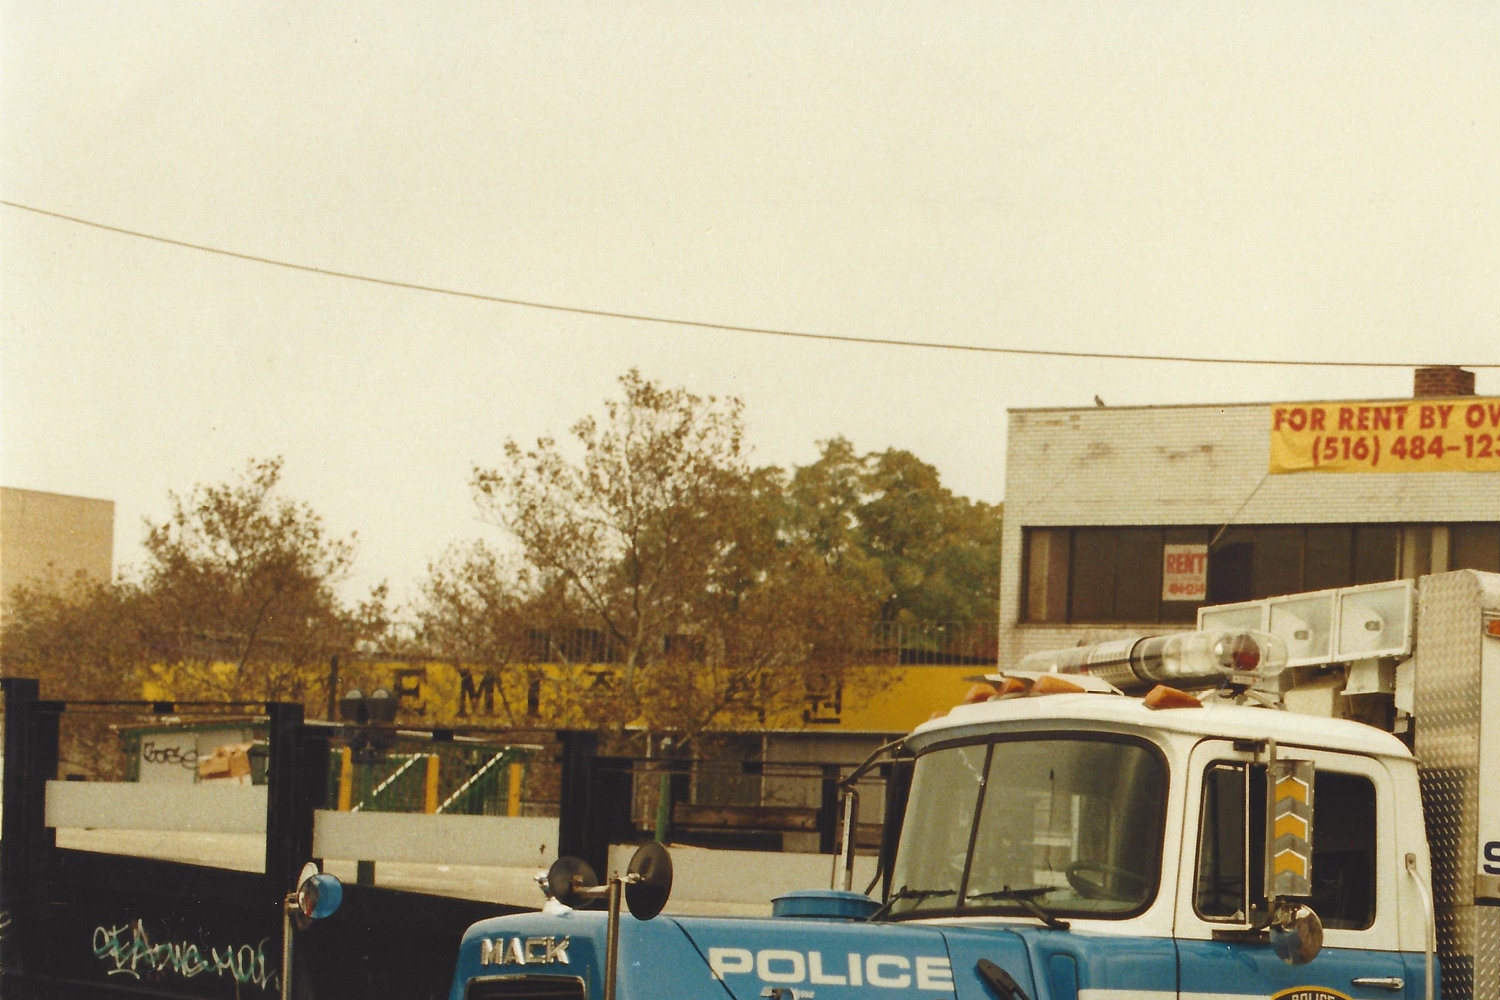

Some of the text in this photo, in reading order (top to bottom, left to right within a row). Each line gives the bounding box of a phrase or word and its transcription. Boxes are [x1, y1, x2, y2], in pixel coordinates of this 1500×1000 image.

[1273, 408, 1326, 432] FOR
[1338, 405, 1409, 431] RENT
[1420, 404, 1454, 429] BY
[1311, 435, 1381, 467] (516)
[1167, 553, 1208, 574] RENT
[481, 935, 570, 966] MACK
[708, 947, 955, 991] POLICE
